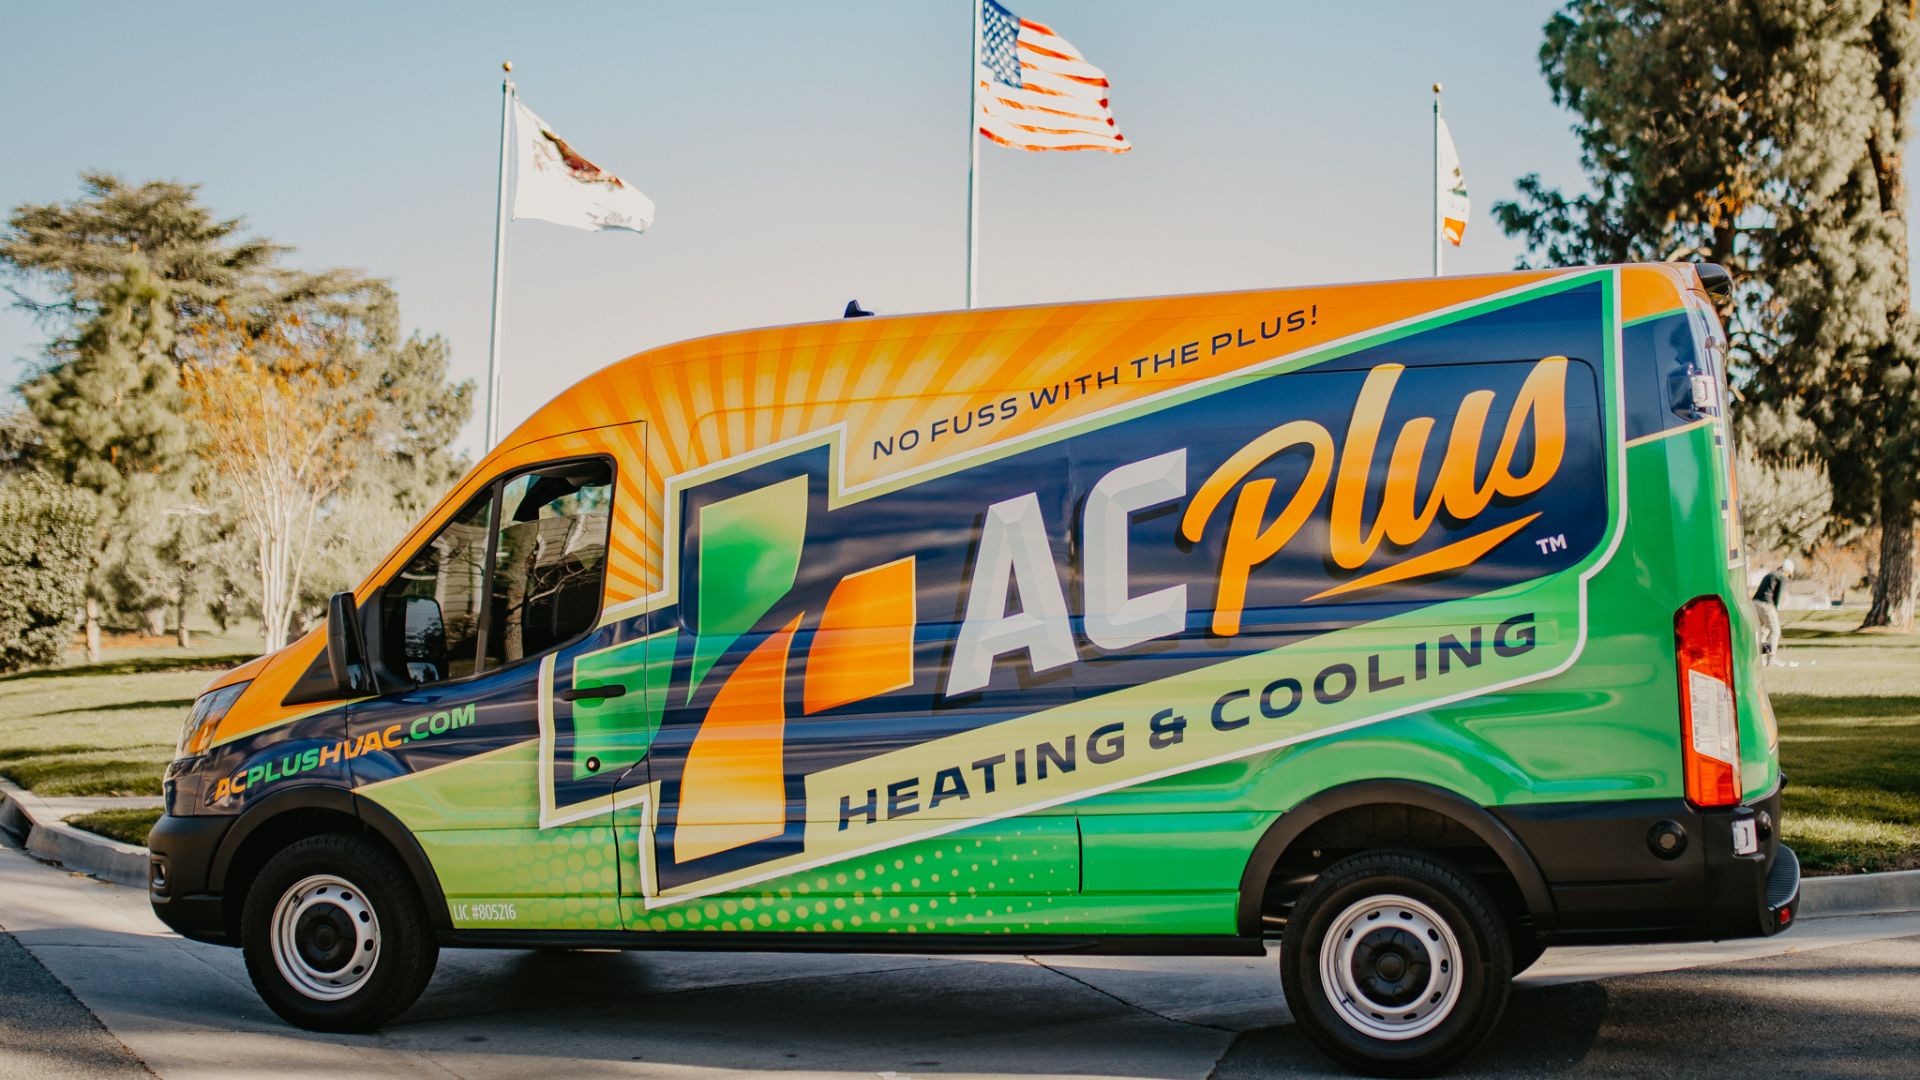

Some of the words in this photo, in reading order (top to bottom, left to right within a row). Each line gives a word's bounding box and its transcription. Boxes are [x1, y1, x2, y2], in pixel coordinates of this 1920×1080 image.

[873, 429, 919, 460] NO
[930, 397, 1018, 442] FUSS
[1030, 366, 1118, 410] WITH
[1130, 341, 1200, 379] THE
[1211, 304, 1318, 356] PLUS!
[945, 447, 1188, 697] AC
[1181, 355, 1569, 637] Plus
[1535, 533, 1568, 555] TM
[214, 703, 476, 801] ACPLUSHVAC.COM
[838, 721, 1125, 831] HEATING
[1149, 707, 1188, 750] &
[1210, 612, 1538, 731] COOLING
[453, 904, 470, 921] LIC
[471, 903, 517, 921] #805216
